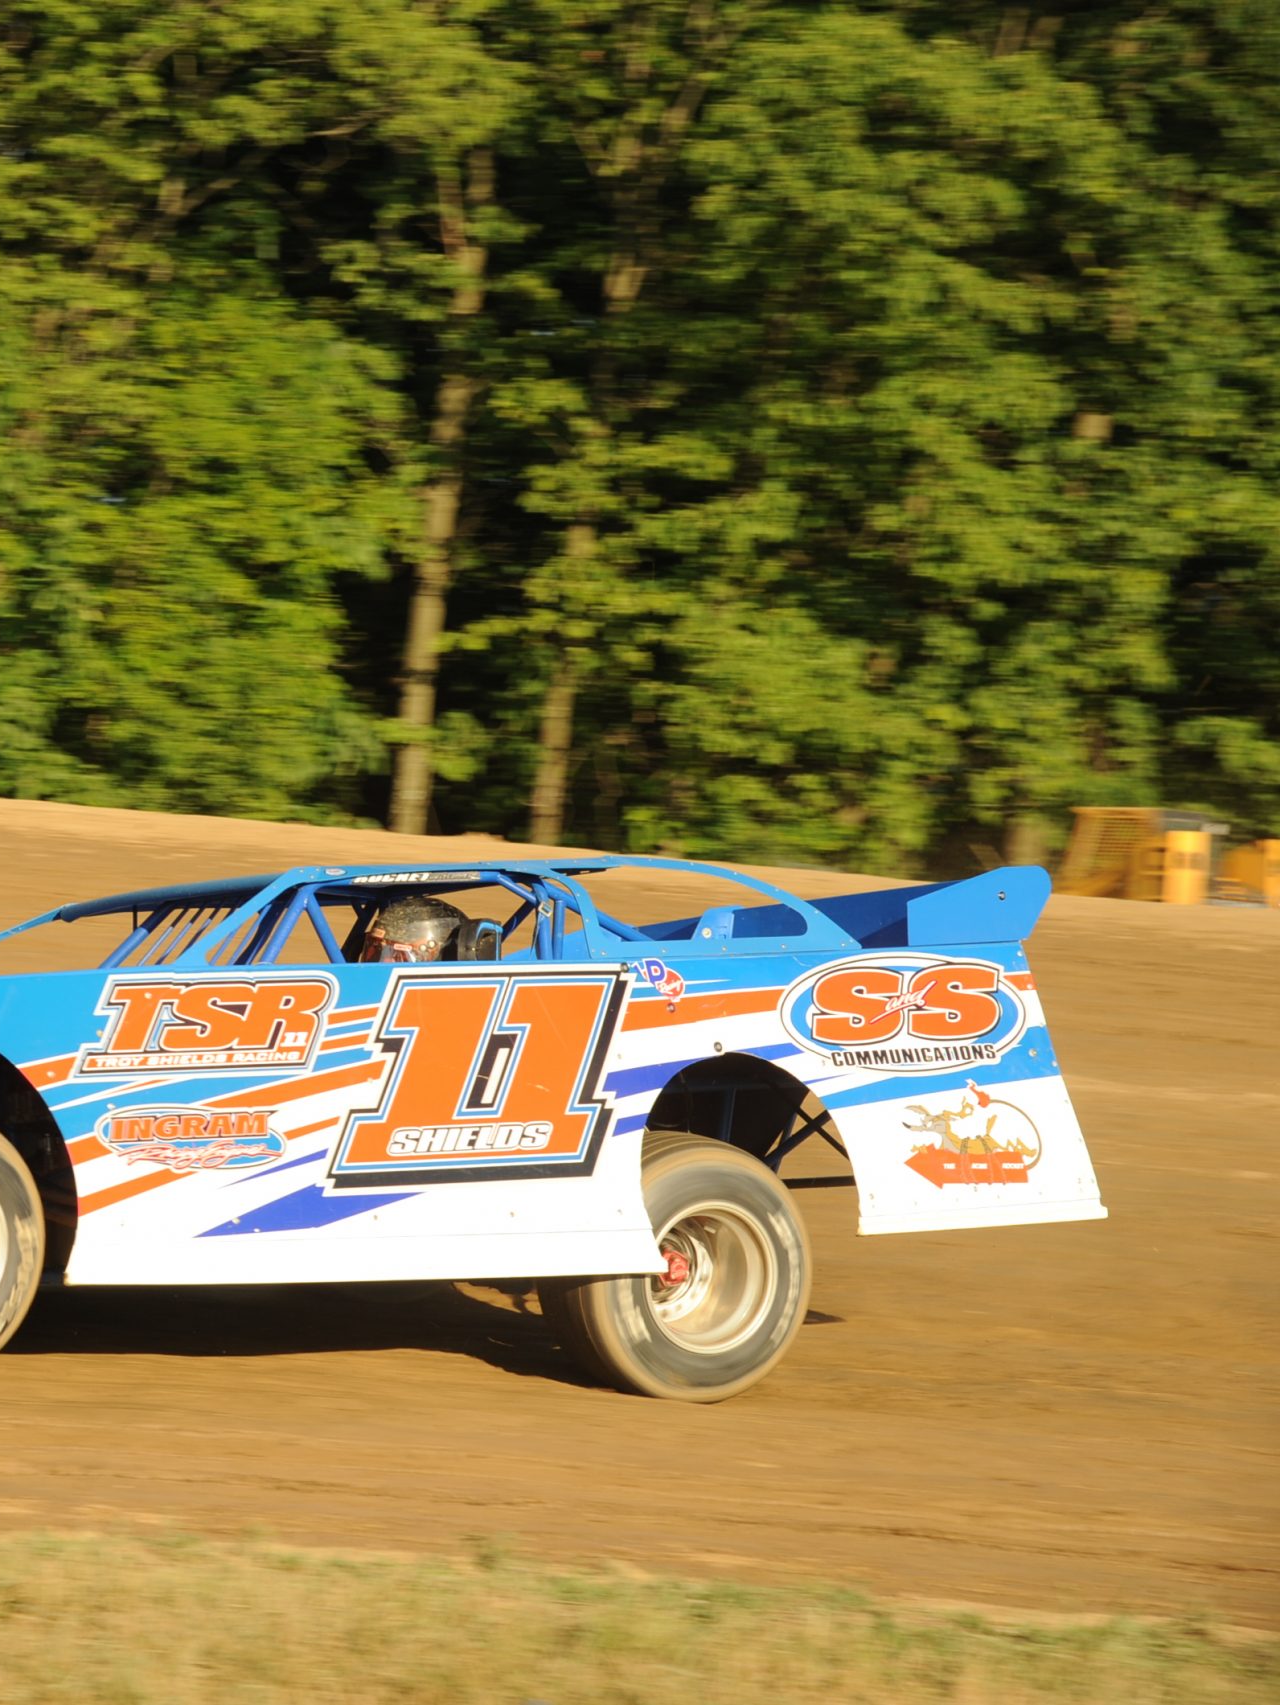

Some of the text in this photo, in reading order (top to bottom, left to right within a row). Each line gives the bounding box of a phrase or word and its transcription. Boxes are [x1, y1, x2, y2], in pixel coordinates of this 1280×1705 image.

[106, 981, 330, 1053] TSR
[280, 1031, 309, 1047] 11
[95, 1051, 300, 1068] TROY SHIELDS RACING
[831, 1044, 997, 1067] COMMUNICATIONS
[335, 977, 618, 1175] 11
[109, 1112, 269, 1142] INGRAM
[388, 1122, 552, 1156] SHIELDS
